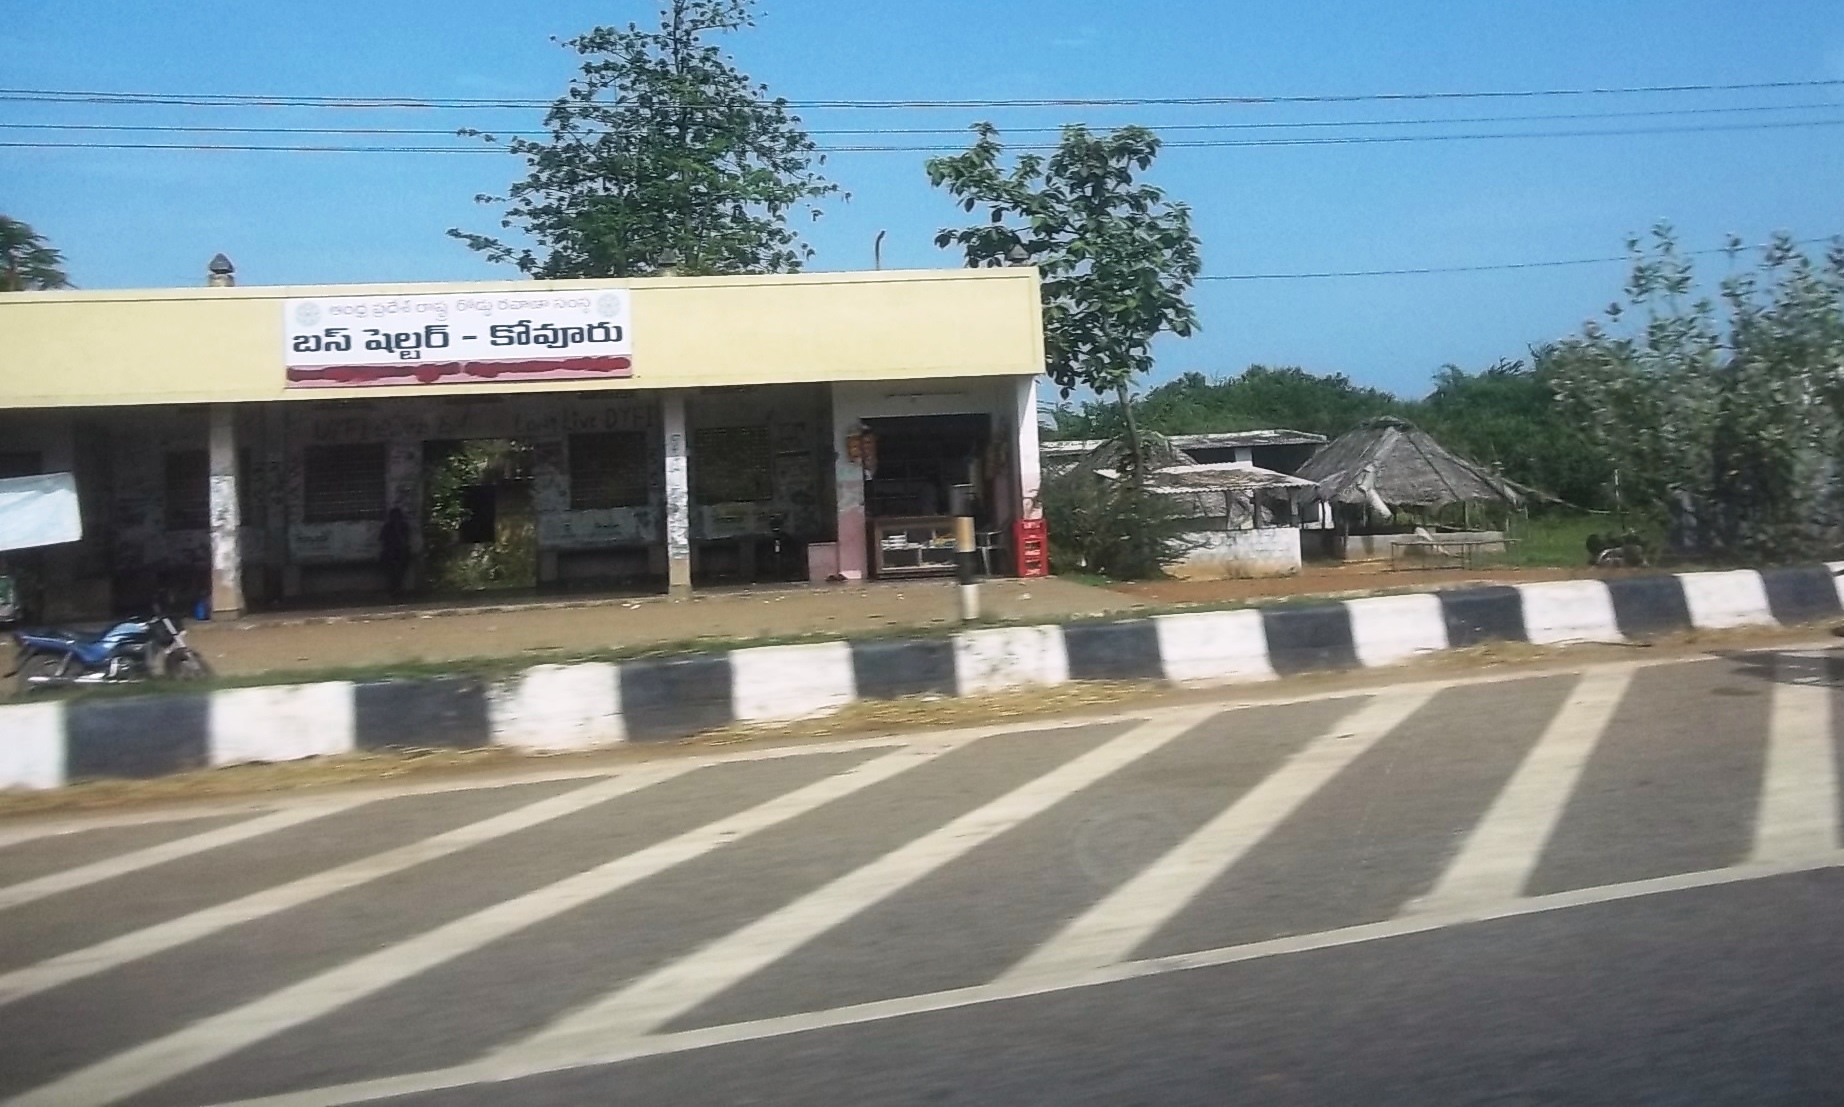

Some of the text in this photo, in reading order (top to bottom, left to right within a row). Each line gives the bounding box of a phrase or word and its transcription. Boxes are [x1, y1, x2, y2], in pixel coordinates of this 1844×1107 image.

[292, 327, 352, 353] బస్
[364, 324, 450, 360] షెల్టర్
[490, 320, 623, 349] కోవూరు
[605, 405, 656, 429] DYFI
